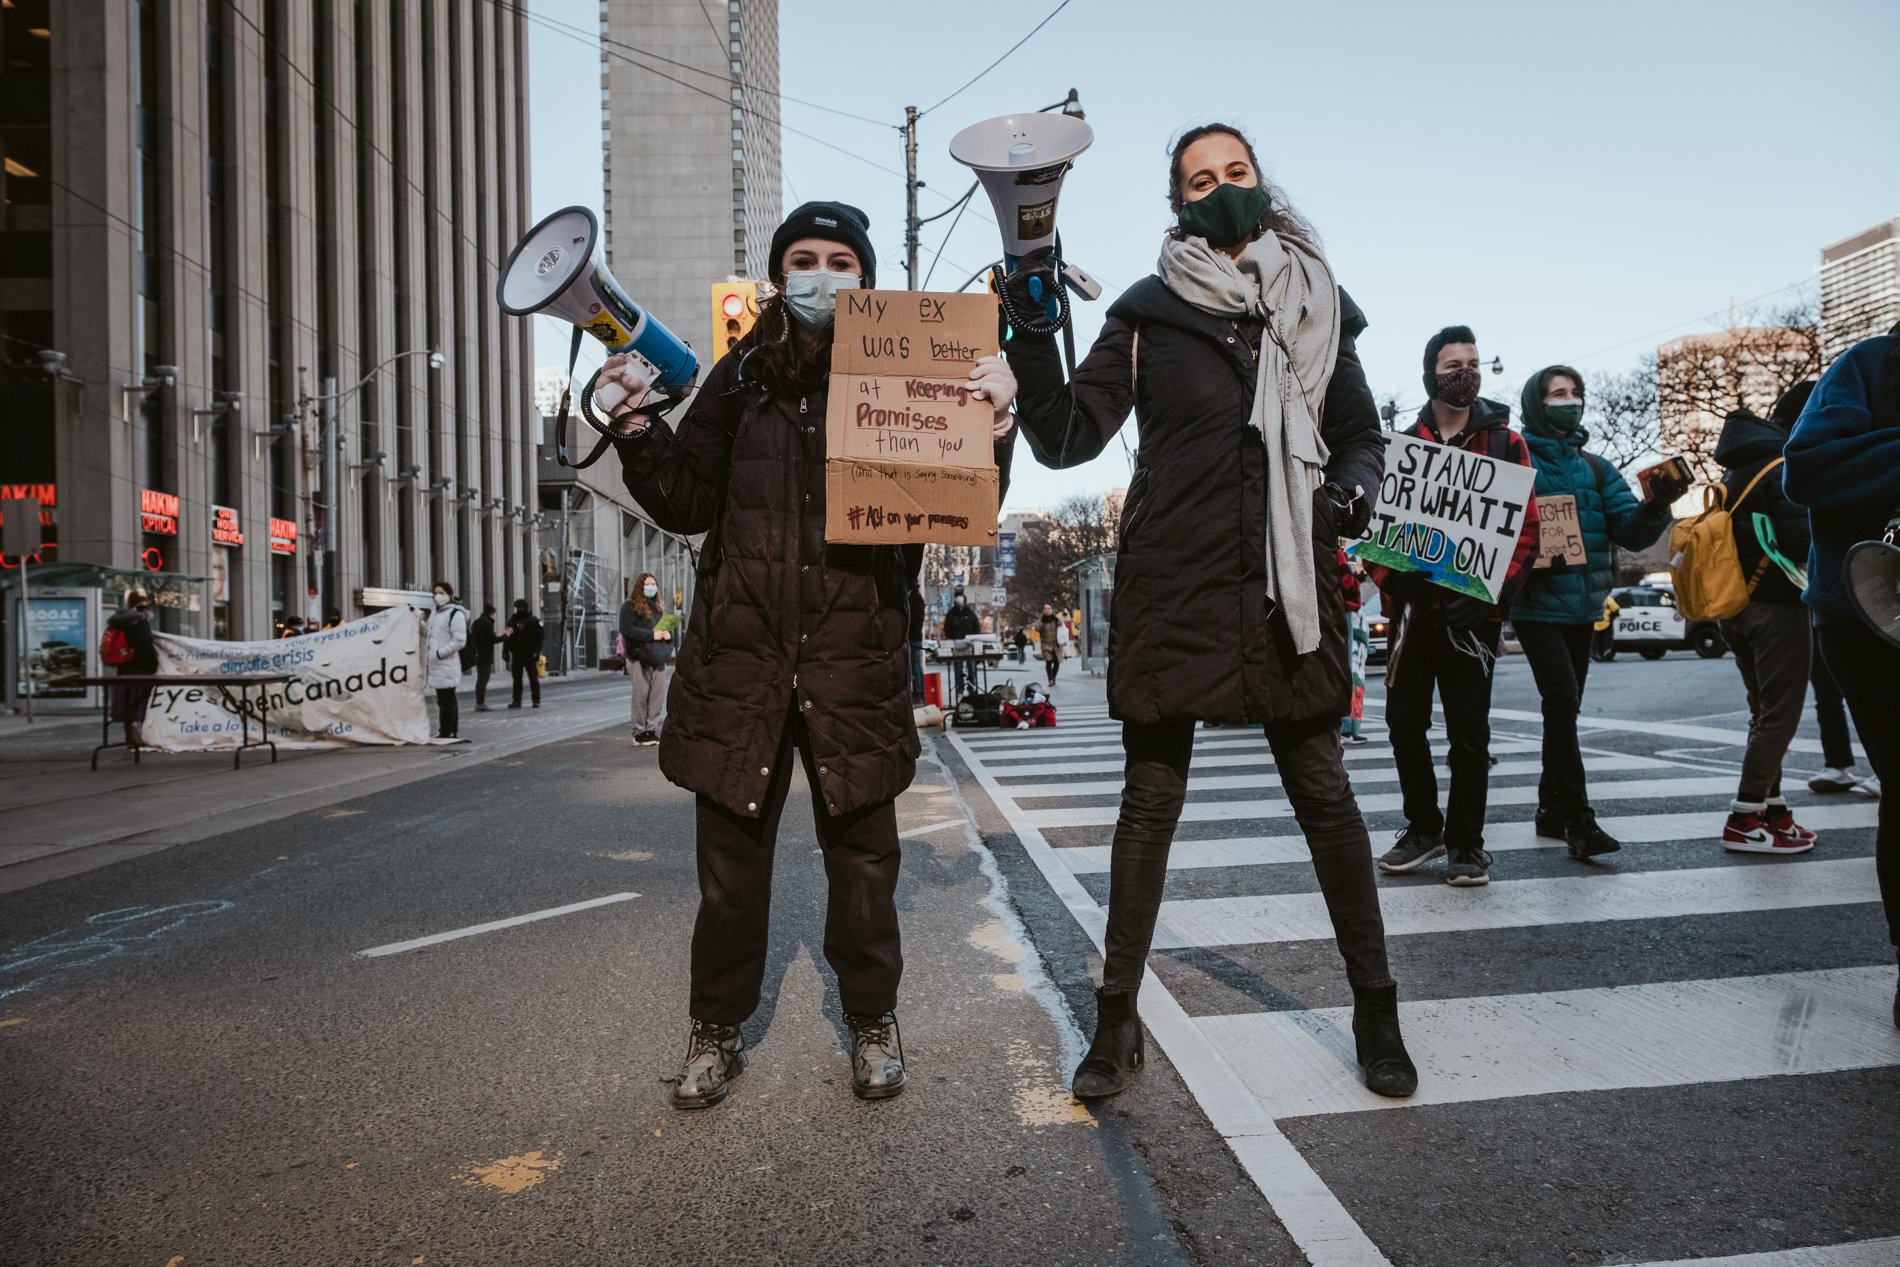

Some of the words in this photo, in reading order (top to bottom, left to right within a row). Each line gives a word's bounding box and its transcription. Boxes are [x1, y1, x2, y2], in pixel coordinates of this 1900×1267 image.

[849, 294, 887, 323] My
[919, 298, 946, 321] ex
[930, 337, 981, 359] better
[860, 379, 881, 399] at
[857, 402, 948, 430] Promises
[875, 430, 919, 453] than
[938, 438, 963, 457] you
[880, 465, 898, 480] that
[904, 470, 912, 479] is
[1398, 443, 1496, 494] STAND
[0, 485, 56, 505] AKIM
[1381, 473, 1416, 510] OR
[142, 490, 179, 517] HAKIM
[1538, 502, 1573, 521] IGHT
[142, 515, 176, 535] OPTICAL
[270, 517, 296, 540] HAKIM
[887, 512, 901, 525] on
[928, 513, 969, 530] promises
[213, 529, 244, 544] SERVICE
[1541, 526, 1565, 538] FOR
[1567, 534, 1582, 556] 5
[1455, 536, 1498, 581] ON
[993, 595, 1005, 604] 40
[314, 630, 340, 644] eyes
[344, 628, 357, 638] to
[360, 623, 379, 635] the
[220, 655, 269, 674] climate
[272, 648, 314, 668] crisis
[179, 721, 208, 733] Take
[213, 724, 221, 732] a
